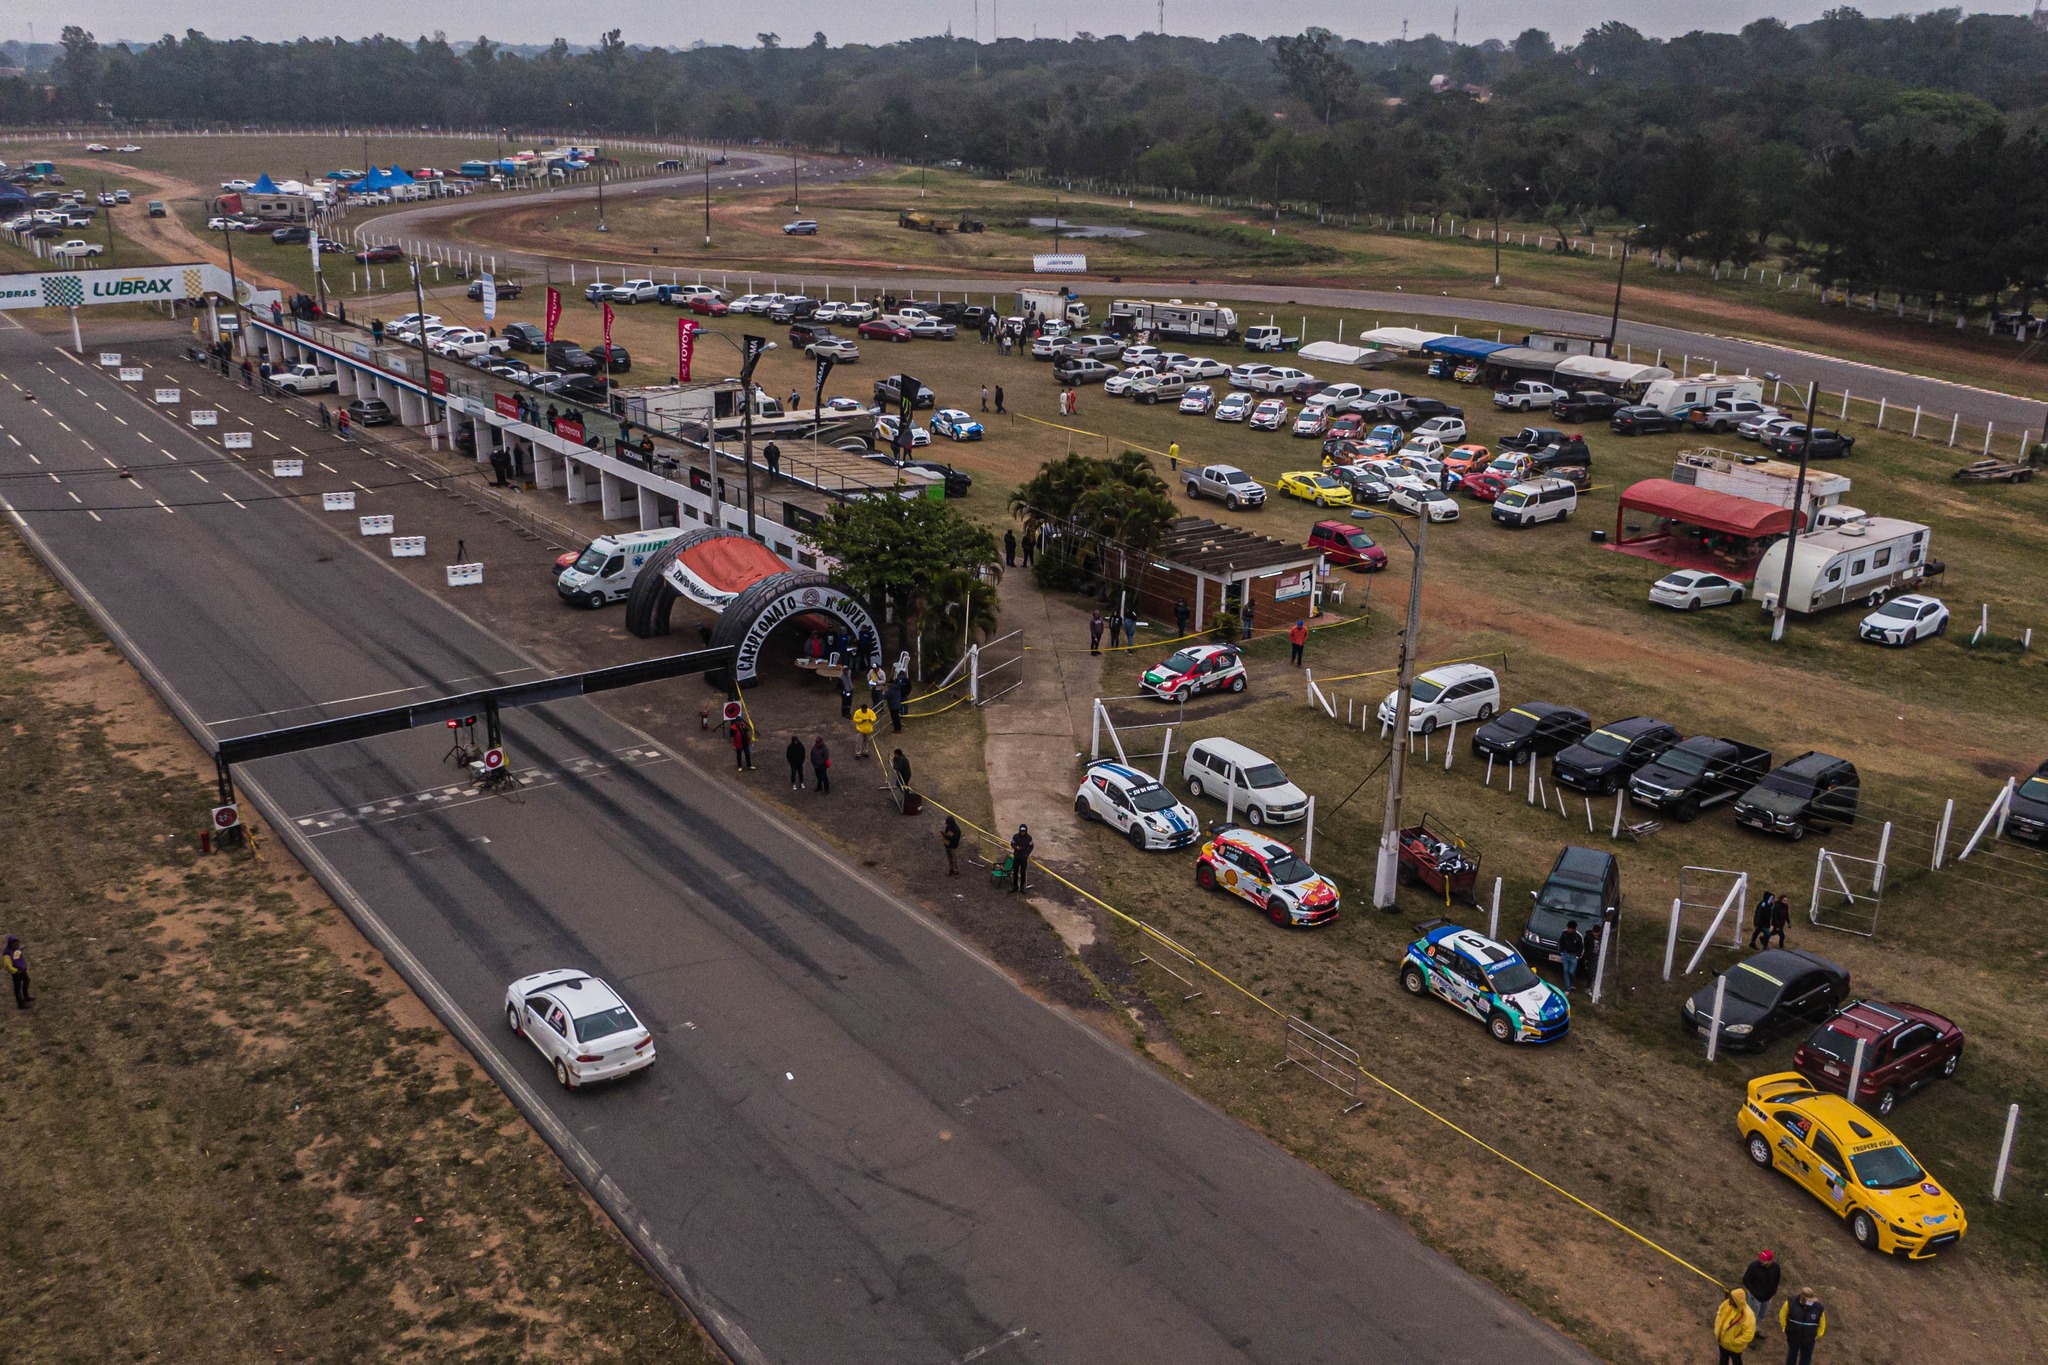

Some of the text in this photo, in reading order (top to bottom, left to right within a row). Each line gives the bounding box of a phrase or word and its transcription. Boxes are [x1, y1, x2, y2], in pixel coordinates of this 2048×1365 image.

[93, 278, 173, 297] LUBRAX
[1024, 300, 1036, 311] 54
[681, 323, 692, 361] TOYOTA
[563, 425, 581, 438] TOYOTA
[737, 596, 796, 671] CAMPEONATO
[1427, 945, 1436, 957] 9
[1797, 1117, 1810, 1132] 26
[1853, 1142, 1878, 1153] TROPERO
